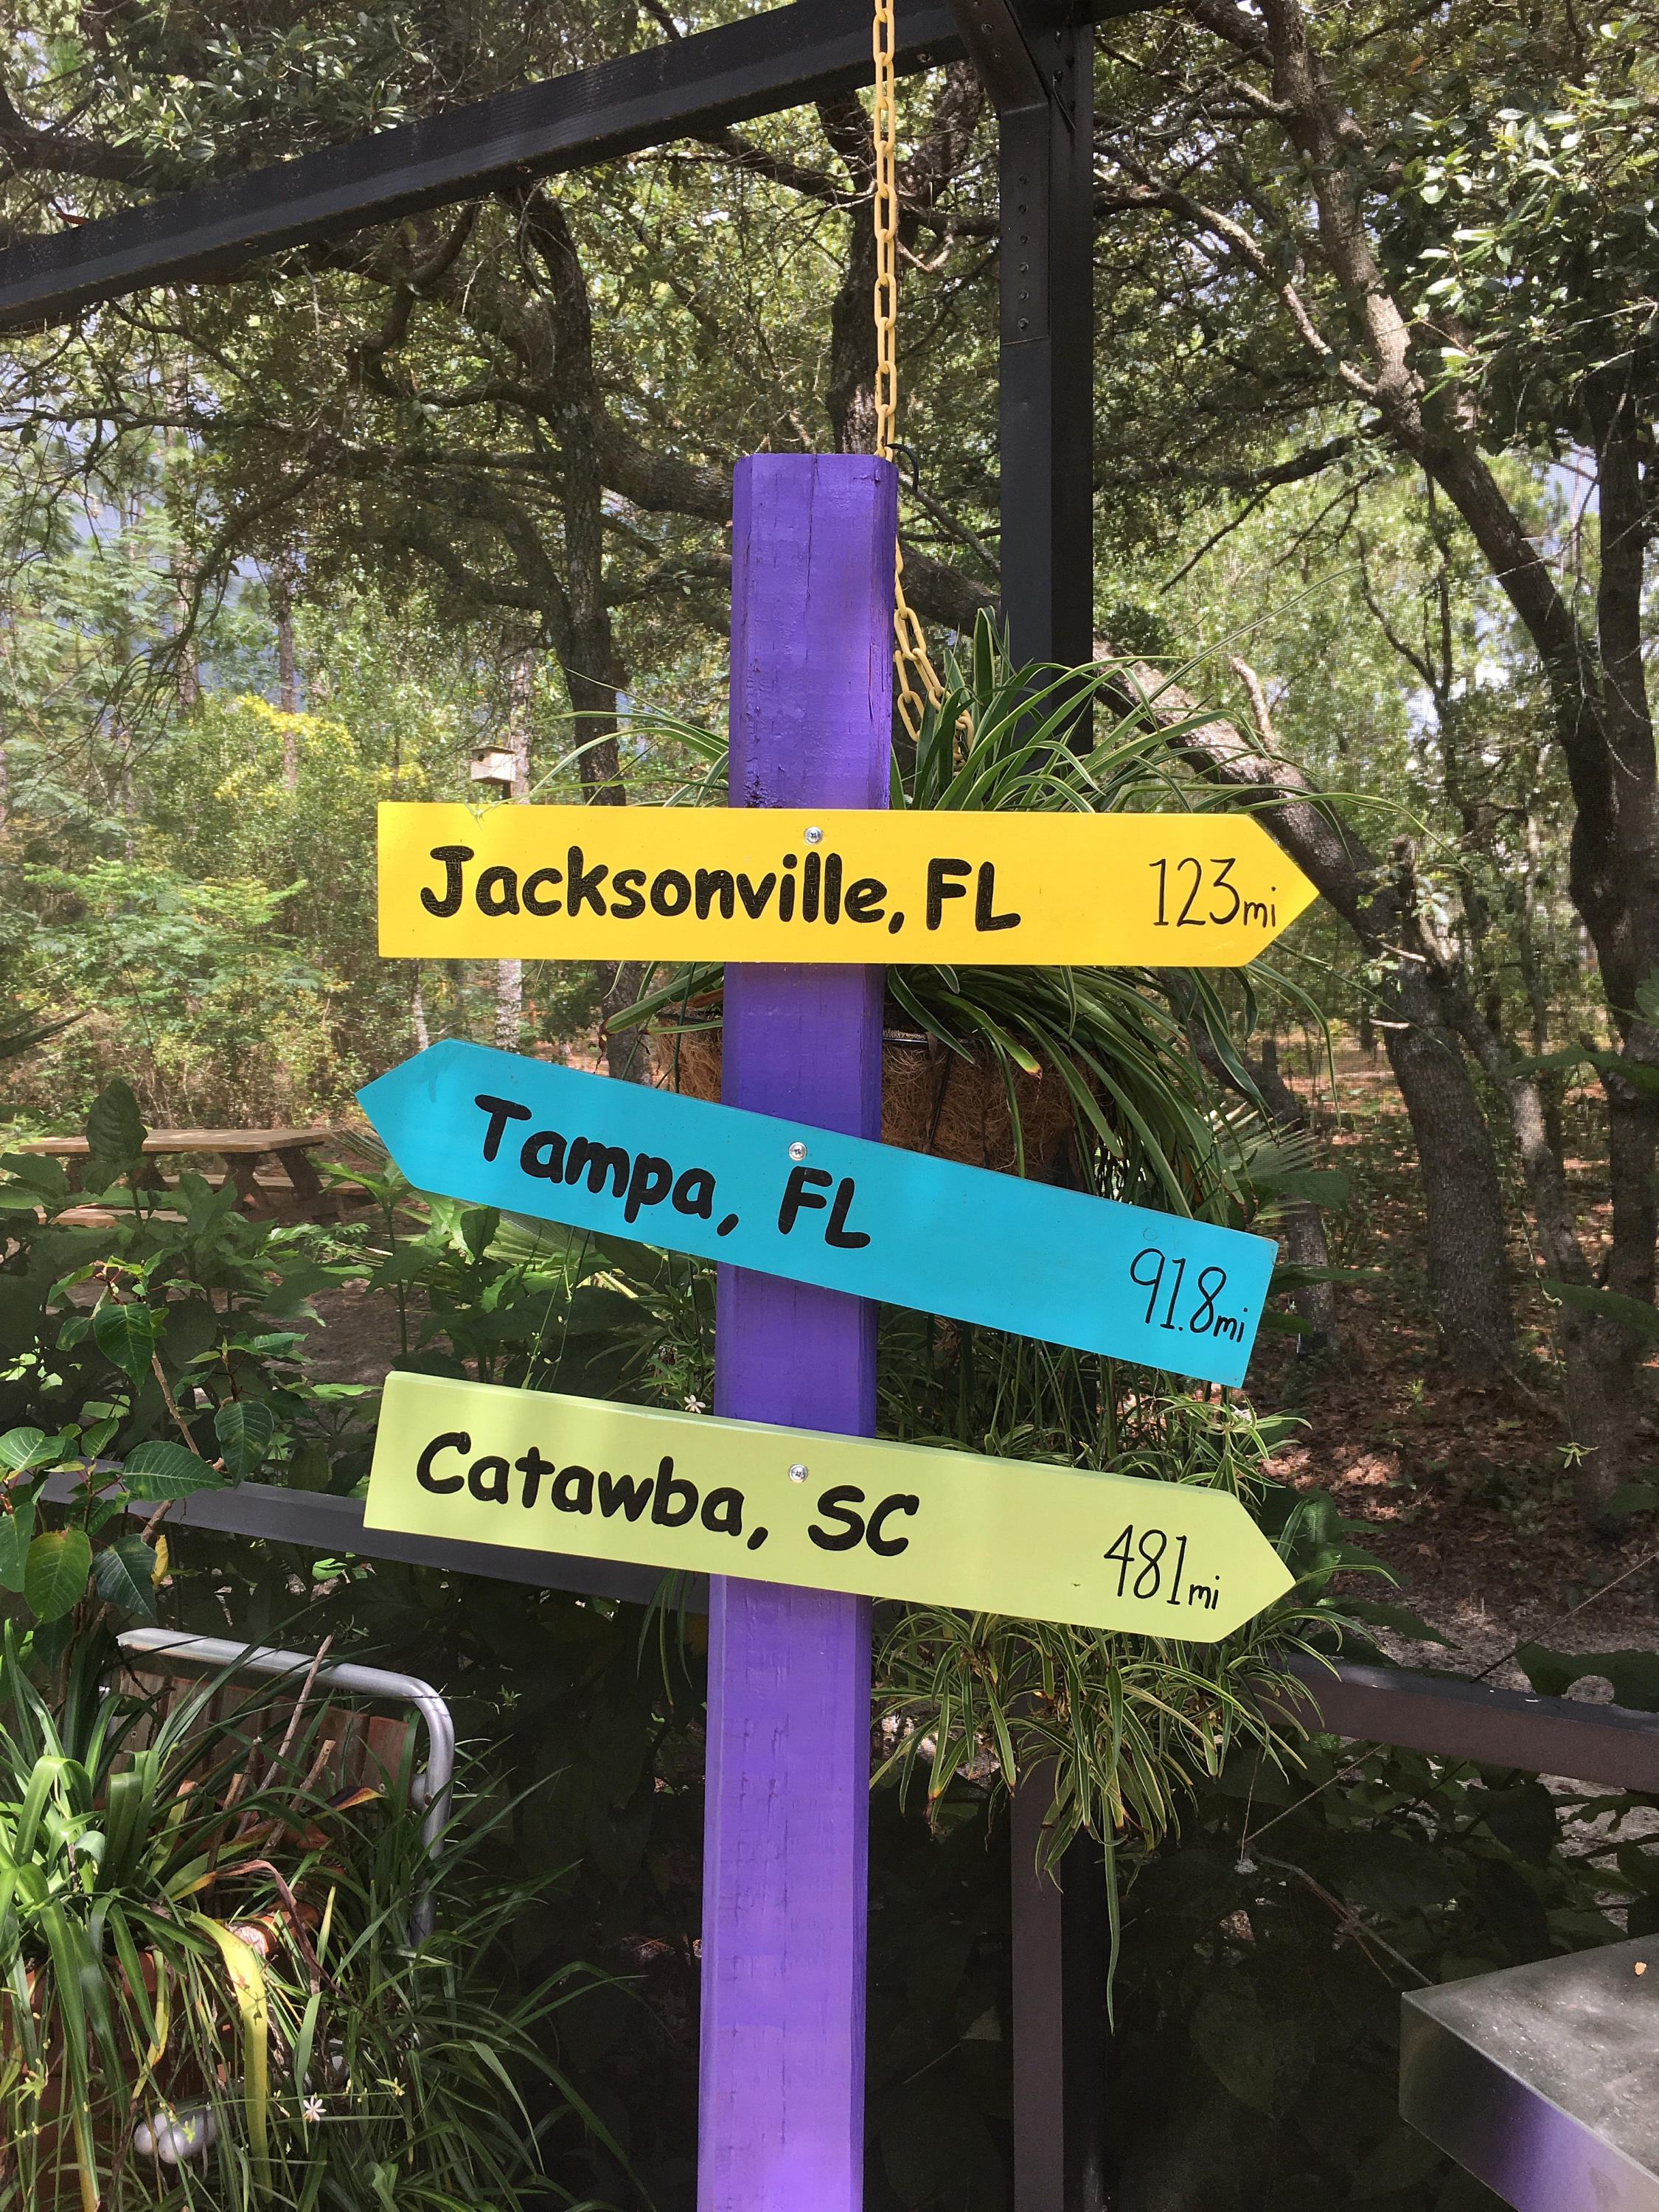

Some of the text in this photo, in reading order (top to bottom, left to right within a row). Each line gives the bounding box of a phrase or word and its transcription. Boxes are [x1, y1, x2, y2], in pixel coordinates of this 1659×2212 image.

[420, 844, 905, 934] Jacksonville,
[926, 858, 1021, 932] FL
[474, 1094, 740, 1238] Tampa,
[778, 1164, 872, 1250] FL
[415, 1431, 769, 1552] Catawba,
[807, 1485, 920, 1558] SC
